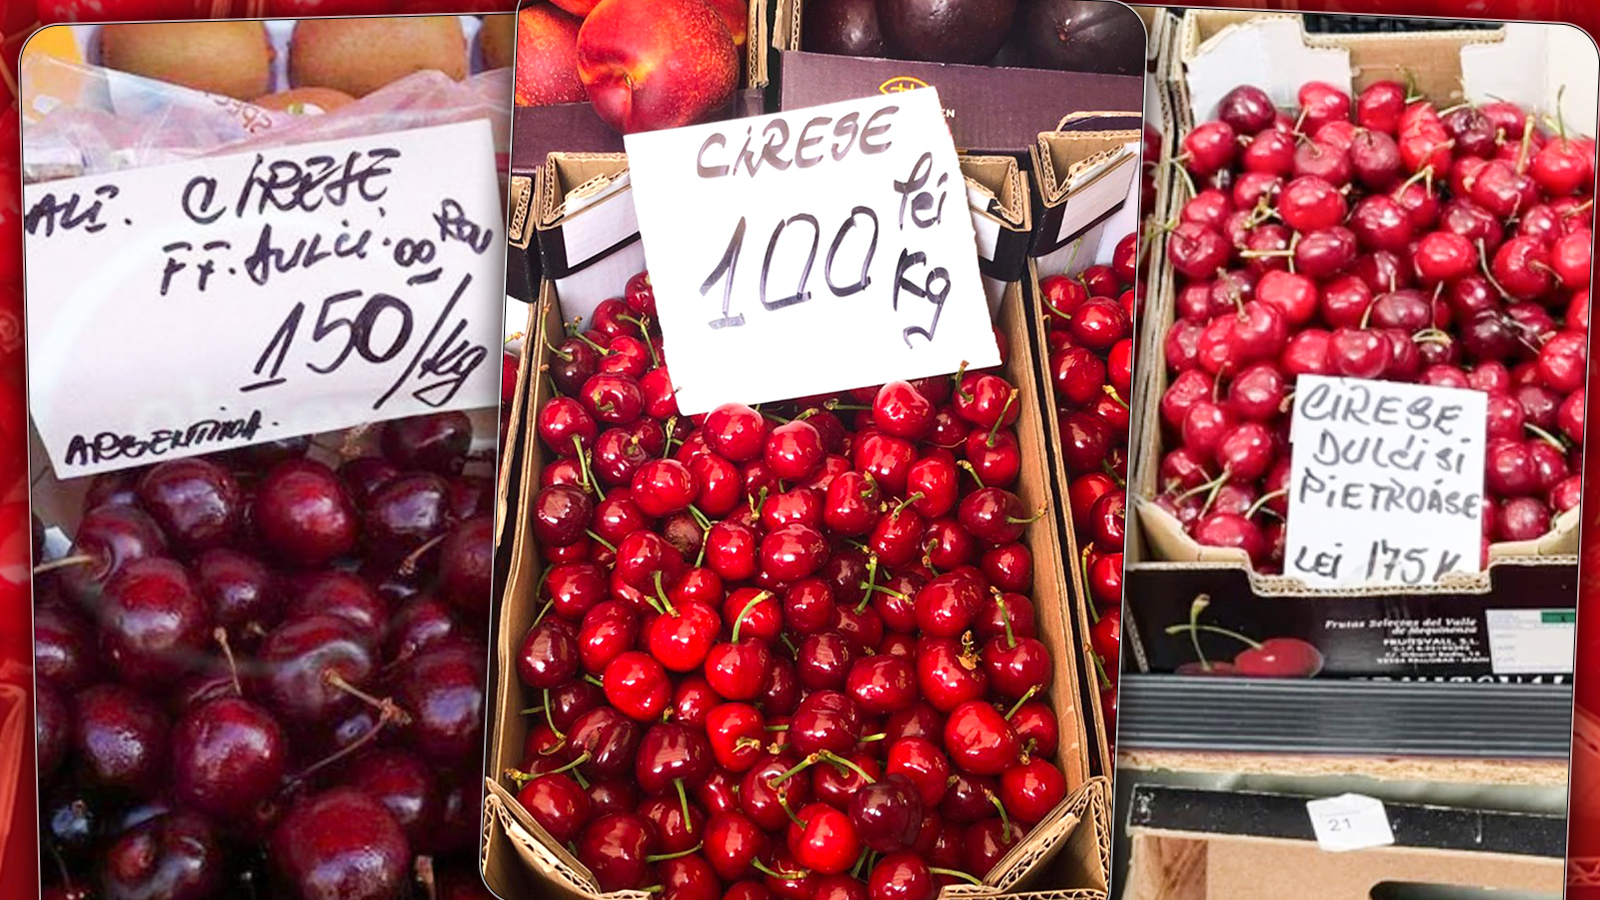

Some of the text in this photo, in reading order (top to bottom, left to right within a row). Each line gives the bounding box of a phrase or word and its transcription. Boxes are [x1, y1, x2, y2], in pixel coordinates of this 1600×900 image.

[696, 105, 899, 179] CIRESE
[699, 205, 880, 330] 100
[1300, 382, 1463, 435] CIRESE
[1366, 539, 1429, 584] 175
[1422, 618, 1441, 626] del
[1445, 618, 1477, 626] Valle
[1328, 818, 1352, 831] 21
